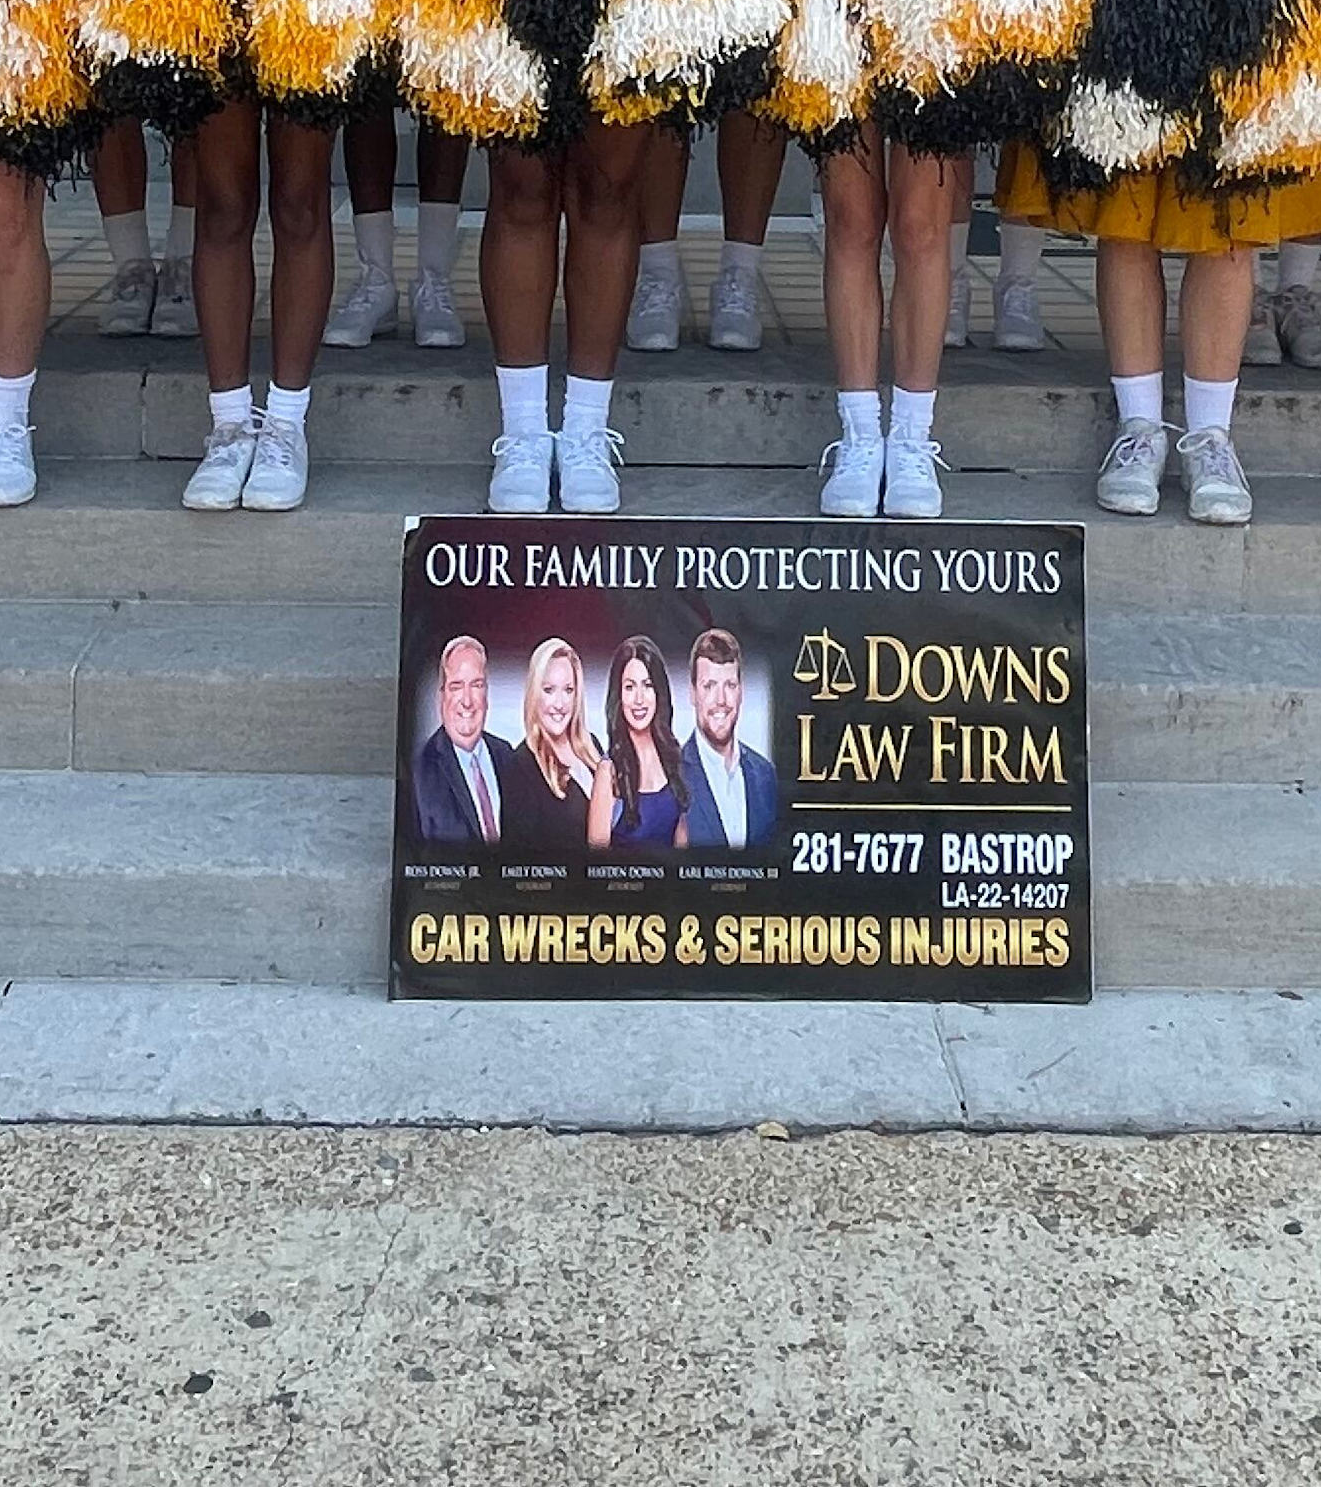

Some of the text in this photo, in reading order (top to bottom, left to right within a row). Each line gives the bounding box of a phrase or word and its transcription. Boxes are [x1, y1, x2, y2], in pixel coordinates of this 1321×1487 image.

[426, 543, 1061, 594] OUR FAMILY PROTECTING YOURS
[864, 634, 1071, 705] DOWNS
[796, 713, 1069, 785] LAW FIRM
[791, 831, 1074, 876] 281-7677 BASTROP
[941, 881, 1070, 909] LA-22-14207
[410, 913, 1071, 967] CAR WRECKS & SERIOUS INJURIES
